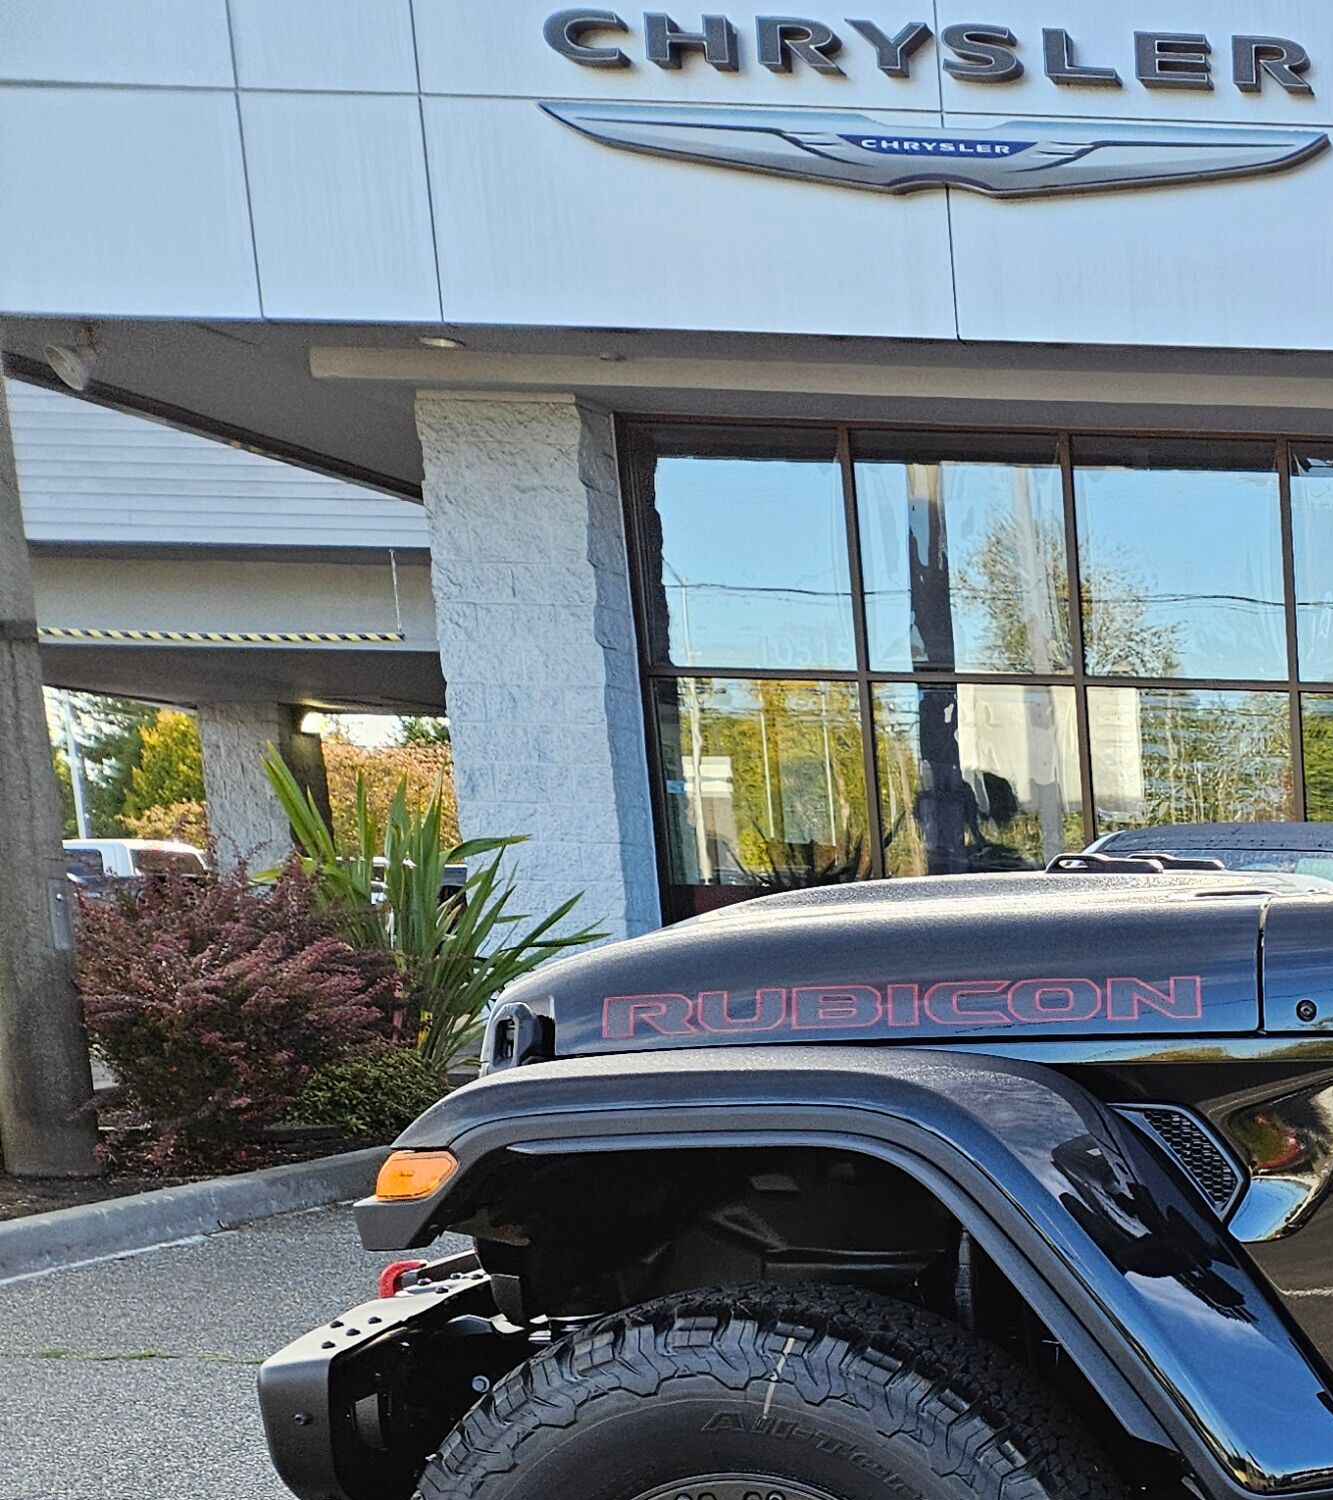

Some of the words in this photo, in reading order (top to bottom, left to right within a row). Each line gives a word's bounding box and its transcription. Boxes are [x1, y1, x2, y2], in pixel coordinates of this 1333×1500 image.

[543, 9, 1315, 97] CHRYSLER
[861, 139, 1010, 154] CHRYSLER
[602, 976, 1201, 1039] RUBICON
